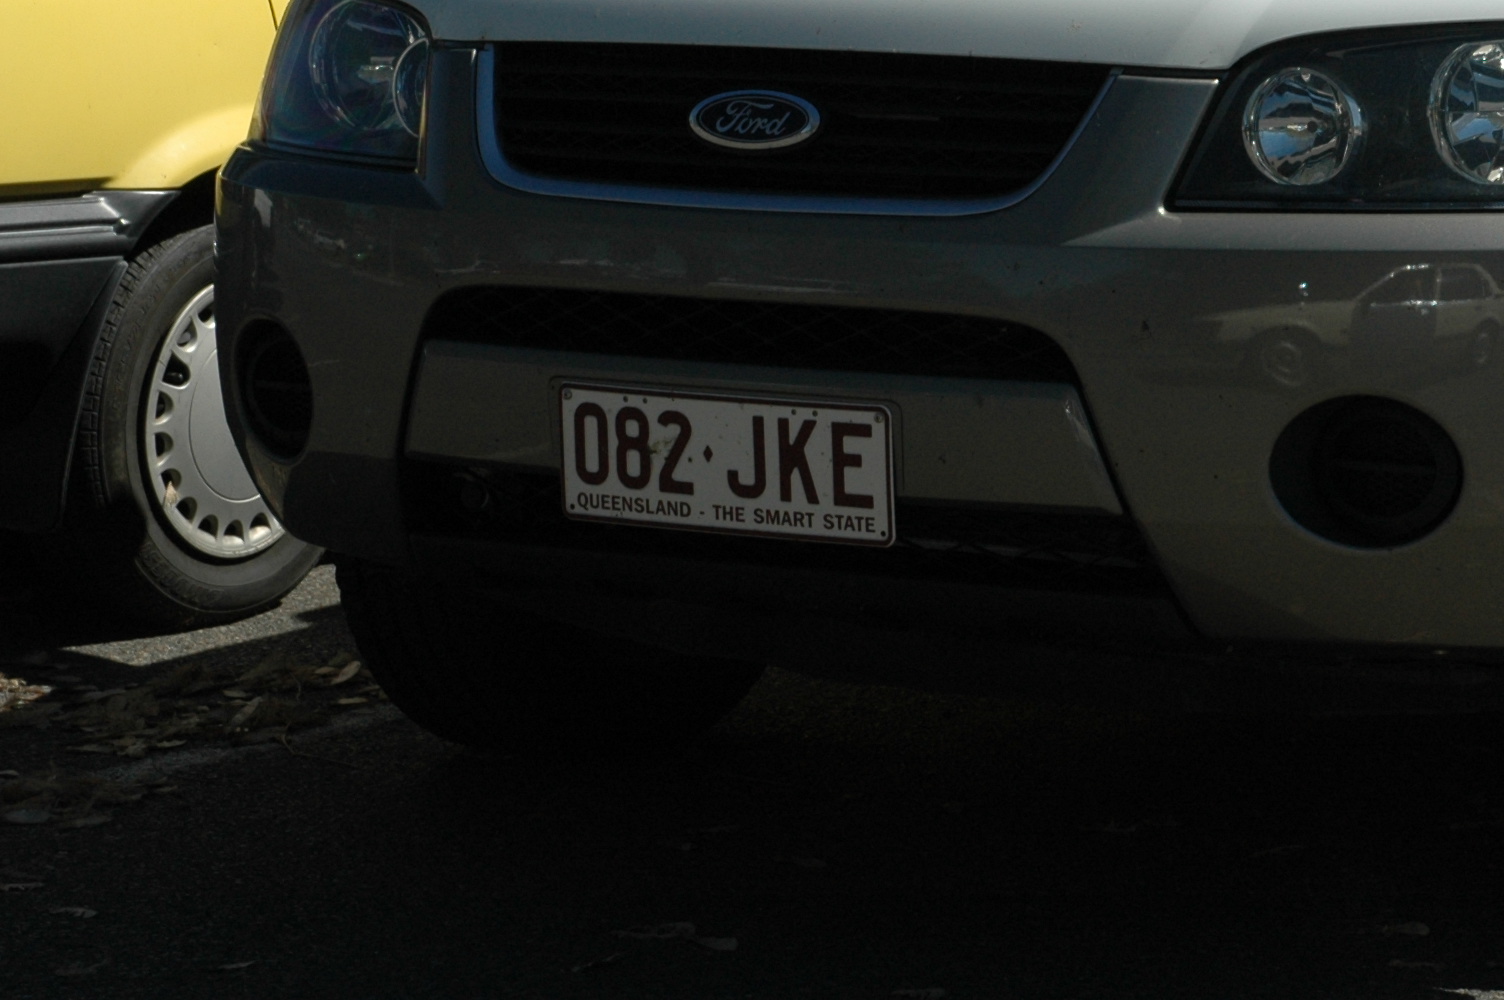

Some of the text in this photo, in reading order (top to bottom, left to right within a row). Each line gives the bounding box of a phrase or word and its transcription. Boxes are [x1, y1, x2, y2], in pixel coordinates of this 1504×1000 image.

[716, 100, 791, 136] Ford
[573, 402, 875, 510] 082 JKE
[577, 492, 692, 518] QUEENSLAND
[712, 505, 746, 524] THE
[753, 508, 815, 529] SMART
[823, 514, 876, 534] STATE
